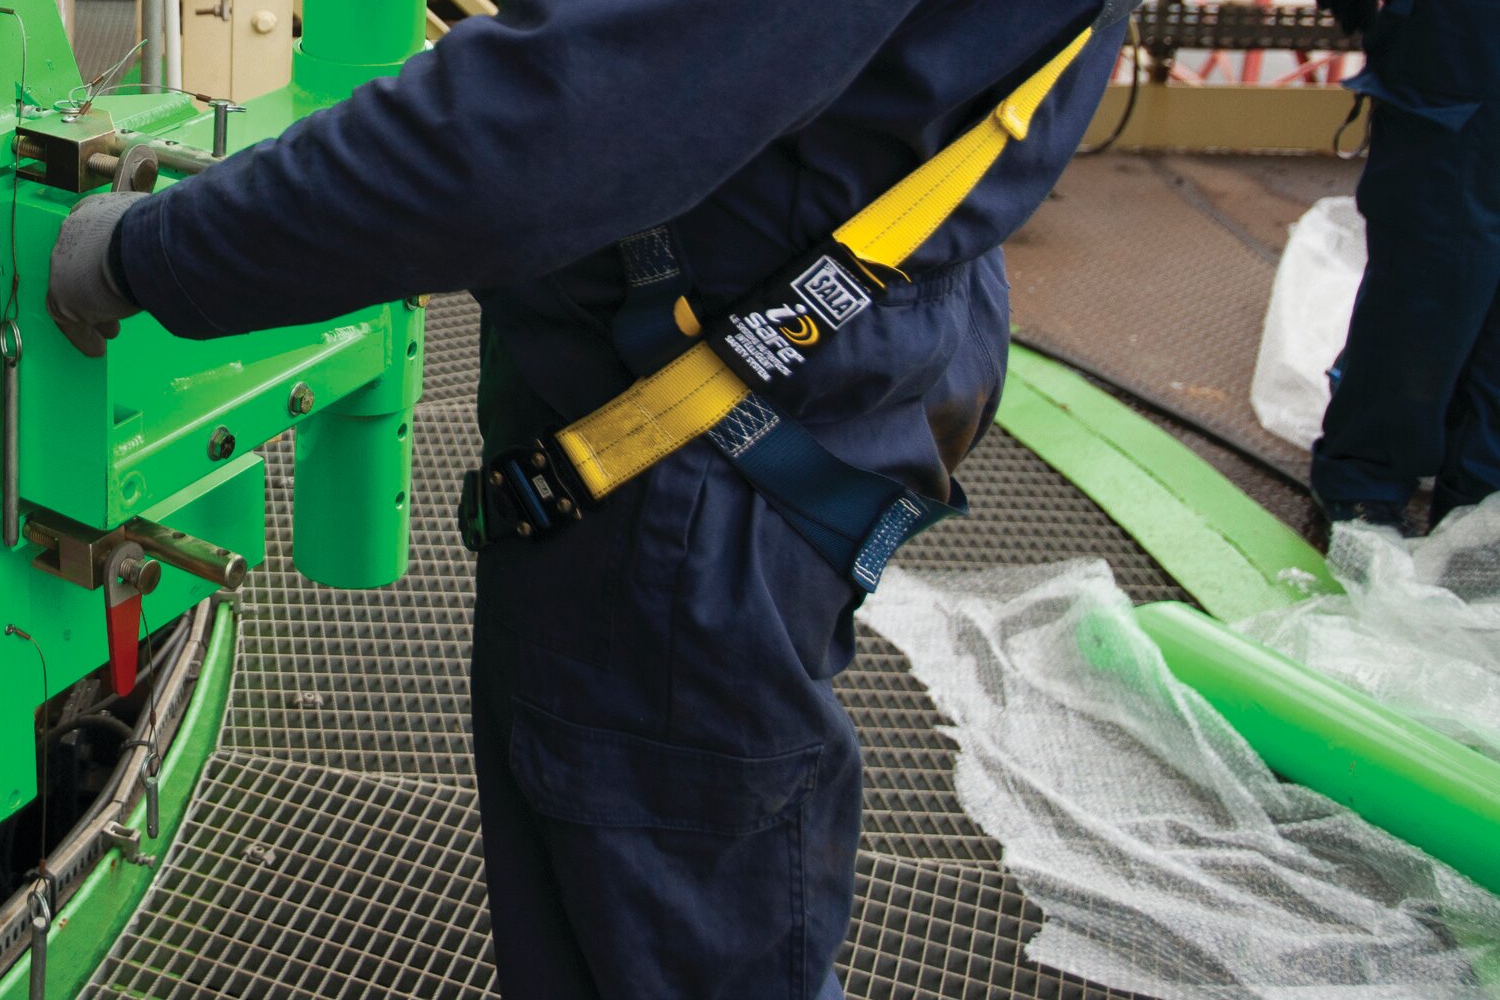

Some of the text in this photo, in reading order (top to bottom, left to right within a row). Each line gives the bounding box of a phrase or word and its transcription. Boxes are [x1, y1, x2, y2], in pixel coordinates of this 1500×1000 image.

[811, 274, 853, 316] SALA
[725, 335, 772, 381] SAFETY SYSTEM
[735, 332, 773, 370] INTELLIGENT
